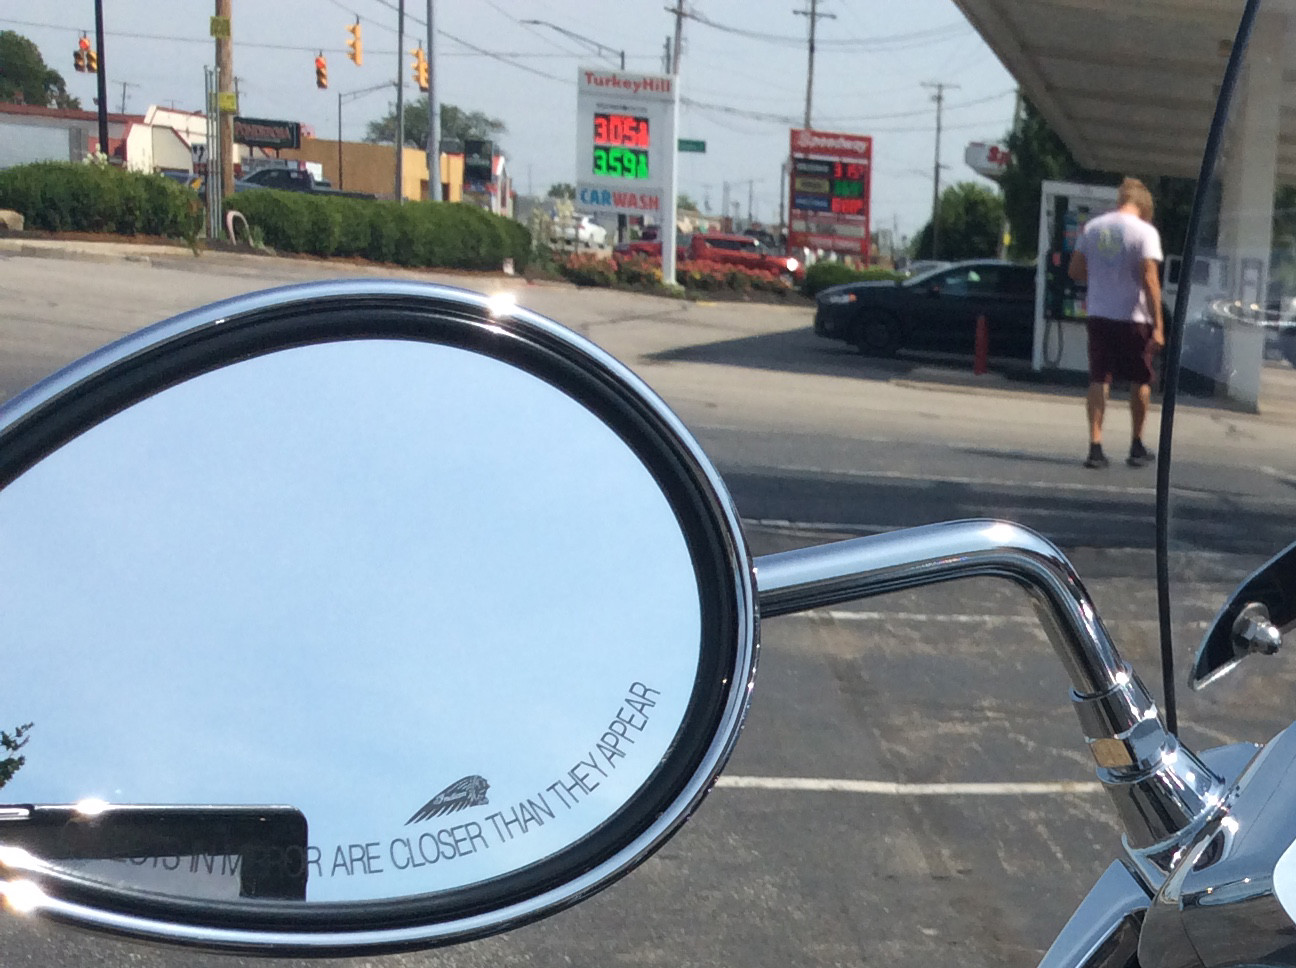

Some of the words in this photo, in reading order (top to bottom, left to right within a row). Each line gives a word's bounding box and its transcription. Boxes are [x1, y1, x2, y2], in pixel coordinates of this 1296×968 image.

[221, 845, 322, 877] MROR
[330, 842, 383, 877] ARE
[389, 821, 489, 870] CLOSER
[485, 792, 555, 843] THAN
[546, 751, 608, 810] THEY
[596, 681, 661, 769] APPEAR
